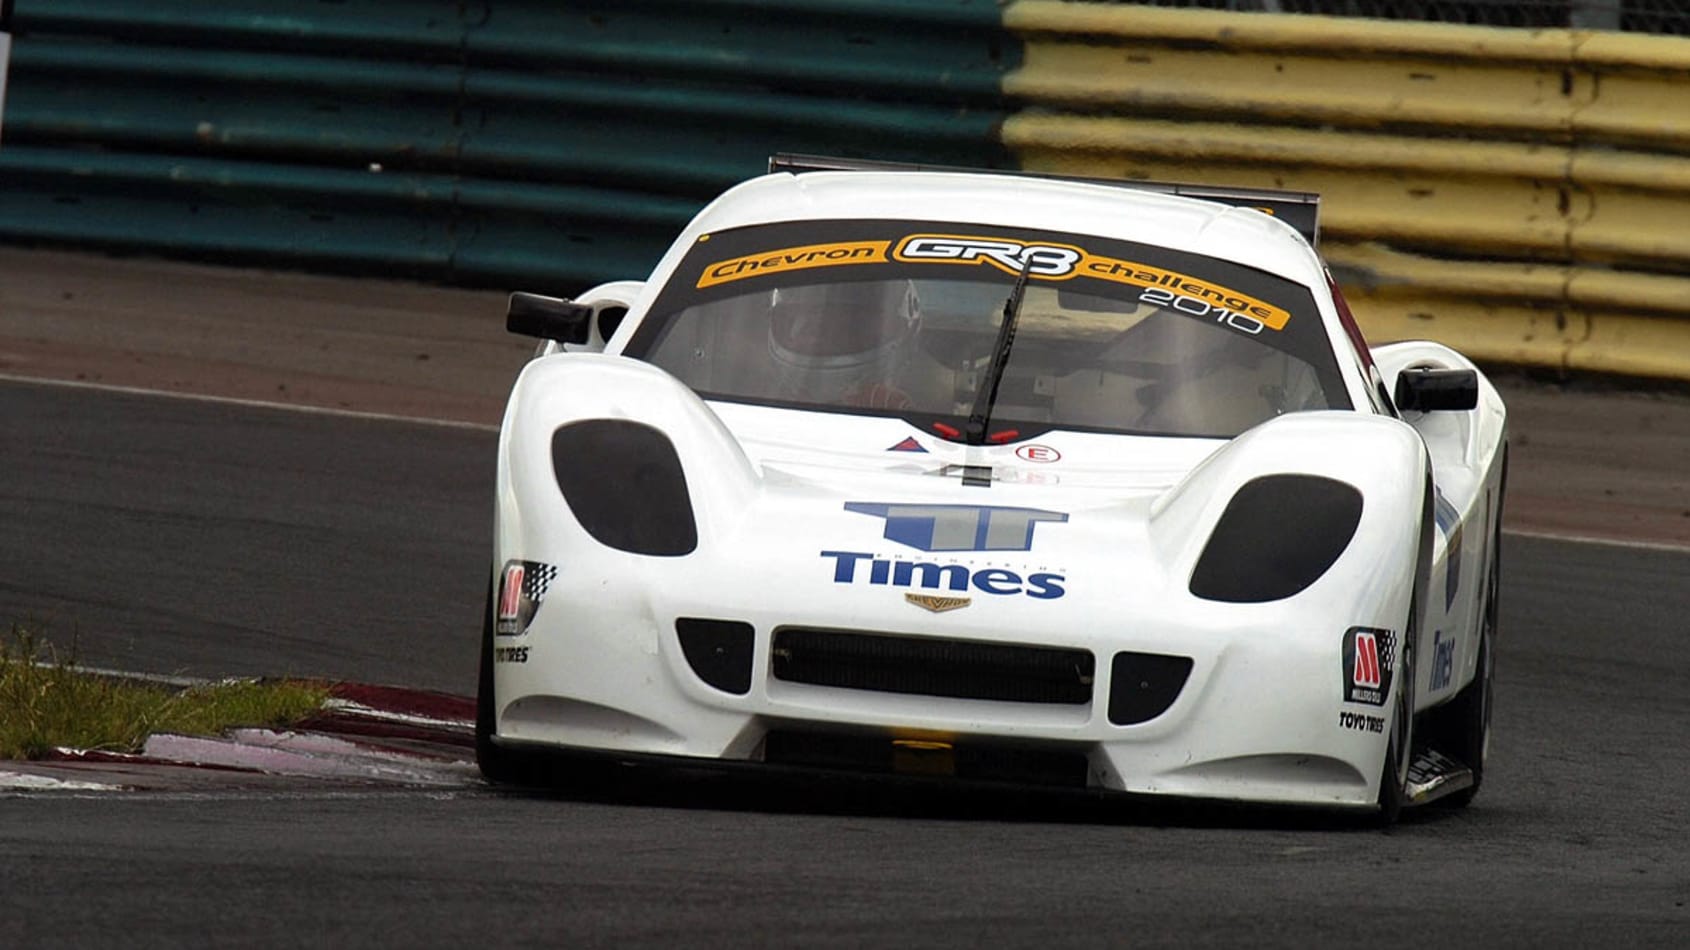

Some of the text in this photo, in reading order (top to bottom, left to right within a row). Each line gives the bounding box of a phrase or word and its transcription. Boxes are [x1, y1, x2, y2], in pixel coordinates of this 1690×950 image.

[711, 239, 1272, 319] Chevron GR8 challenge
[1138, 287, 1265, 335] 2010
[820, 550, 1066, 600] Times
[1340, 711, 1384, 734] TOYO TIRES
